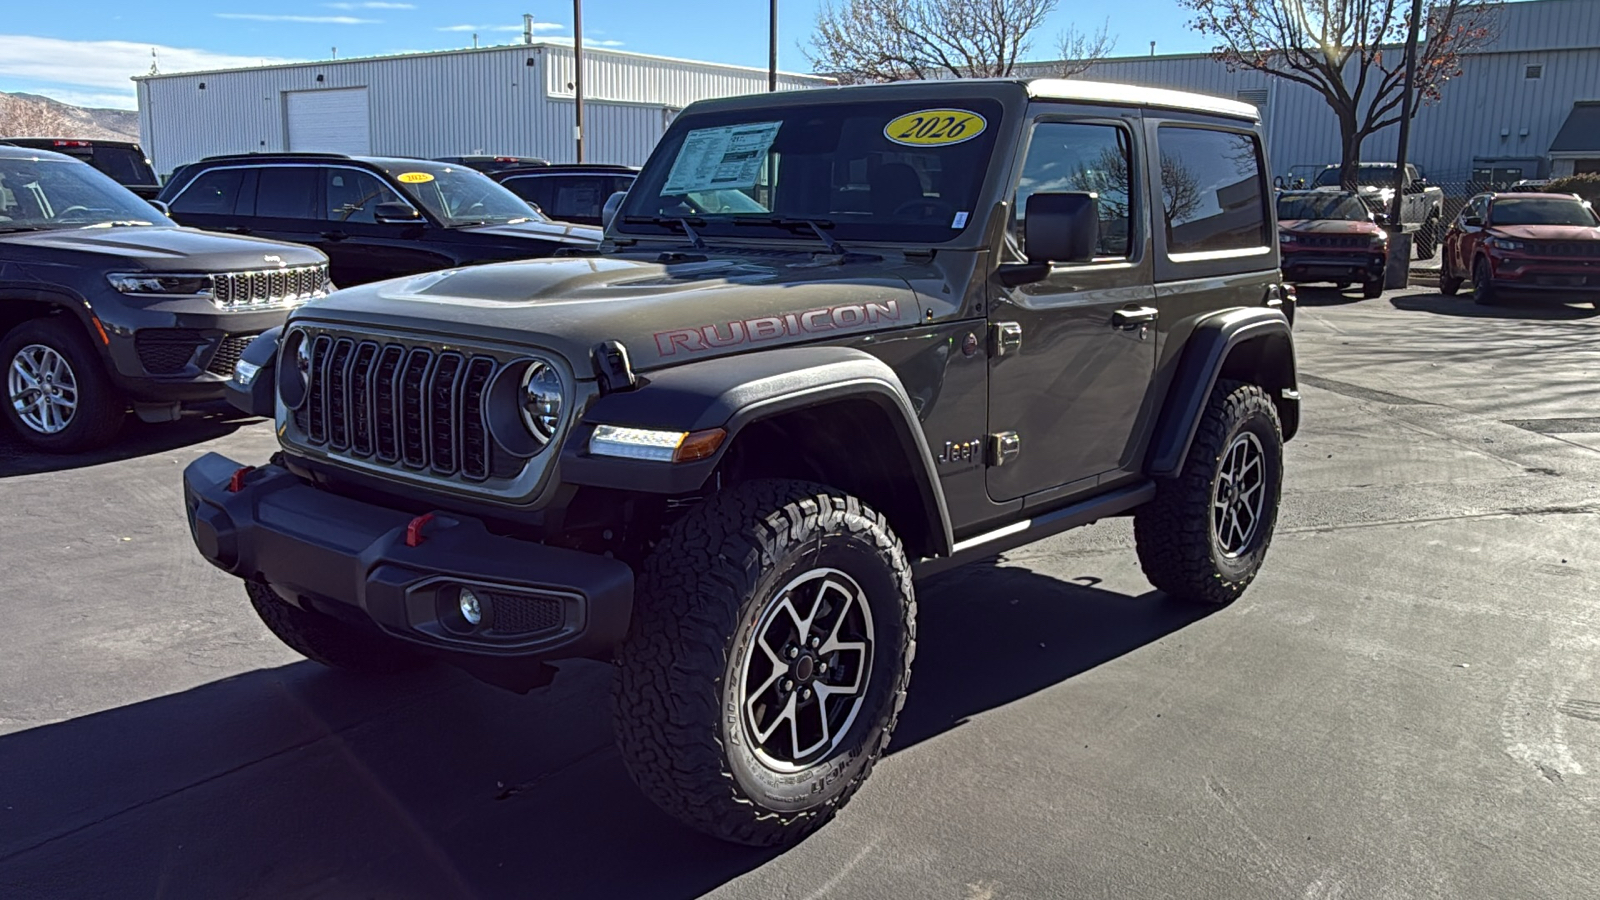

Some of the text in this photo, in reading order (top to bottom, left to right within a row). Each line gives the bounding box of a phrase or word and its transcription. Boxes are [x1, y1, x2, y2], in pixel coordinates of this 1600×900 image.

[897, 116, 974, 139] 2026
[653, 298, 901, 357] RUBICON
[938, 438, 980, 464] Jeep
